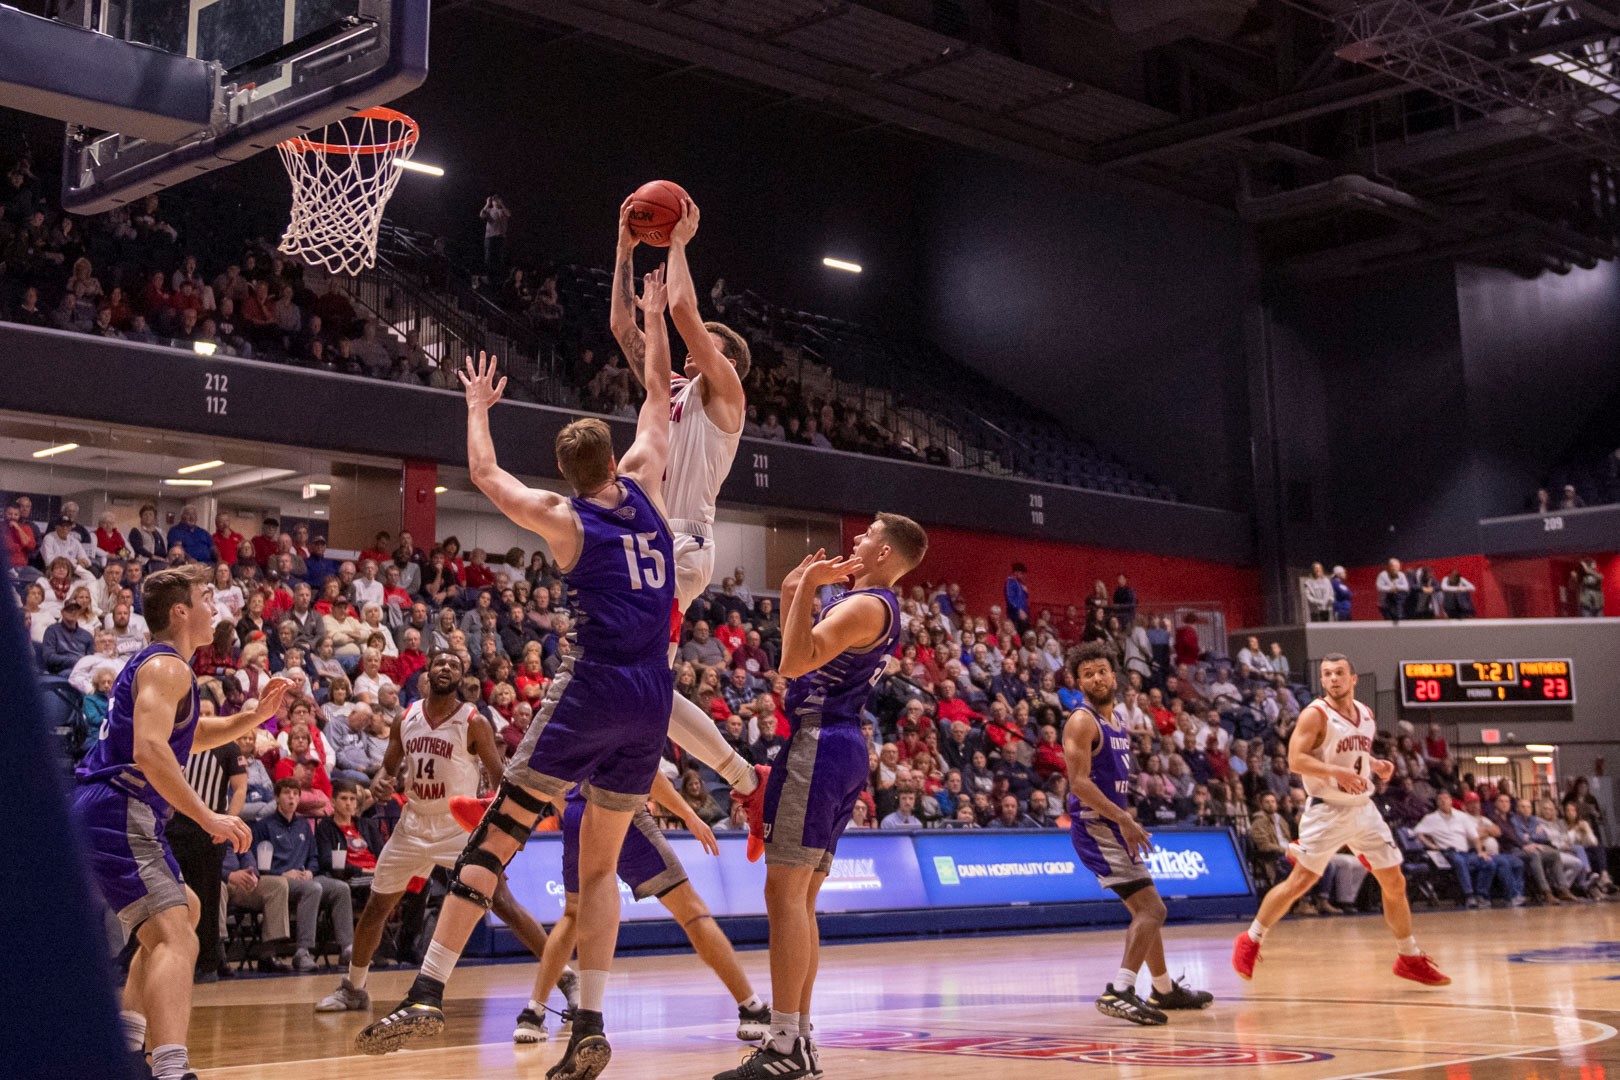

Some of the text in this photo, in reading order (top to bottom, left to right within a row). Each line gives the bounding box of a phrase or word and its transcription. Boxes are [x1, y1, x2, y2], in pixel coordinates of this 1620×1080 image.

[205, 372, 228, 392] 212
[206, 395, 228, 415] 112
[752, 453, 768, 469] 211
[754, 472, 769, 488] 111
[619, 530, 666, 590] 15
[1473, 662, 1515, 682] 7:21
[1415, 679, 1441, 701] 20
[1543, 678, 1568, 699] 23
[406, 736, 454, 760] SOUTHERN
[1336, 735, 1372, 753] SOUTHE
[416, 758, 435, 779] 14
[1353, 756, 1362, 775] 4
[411, 782, 446, 800] DIANA
[957, 861, 1075, 877] DUNN HOSPITALITY GROUP
